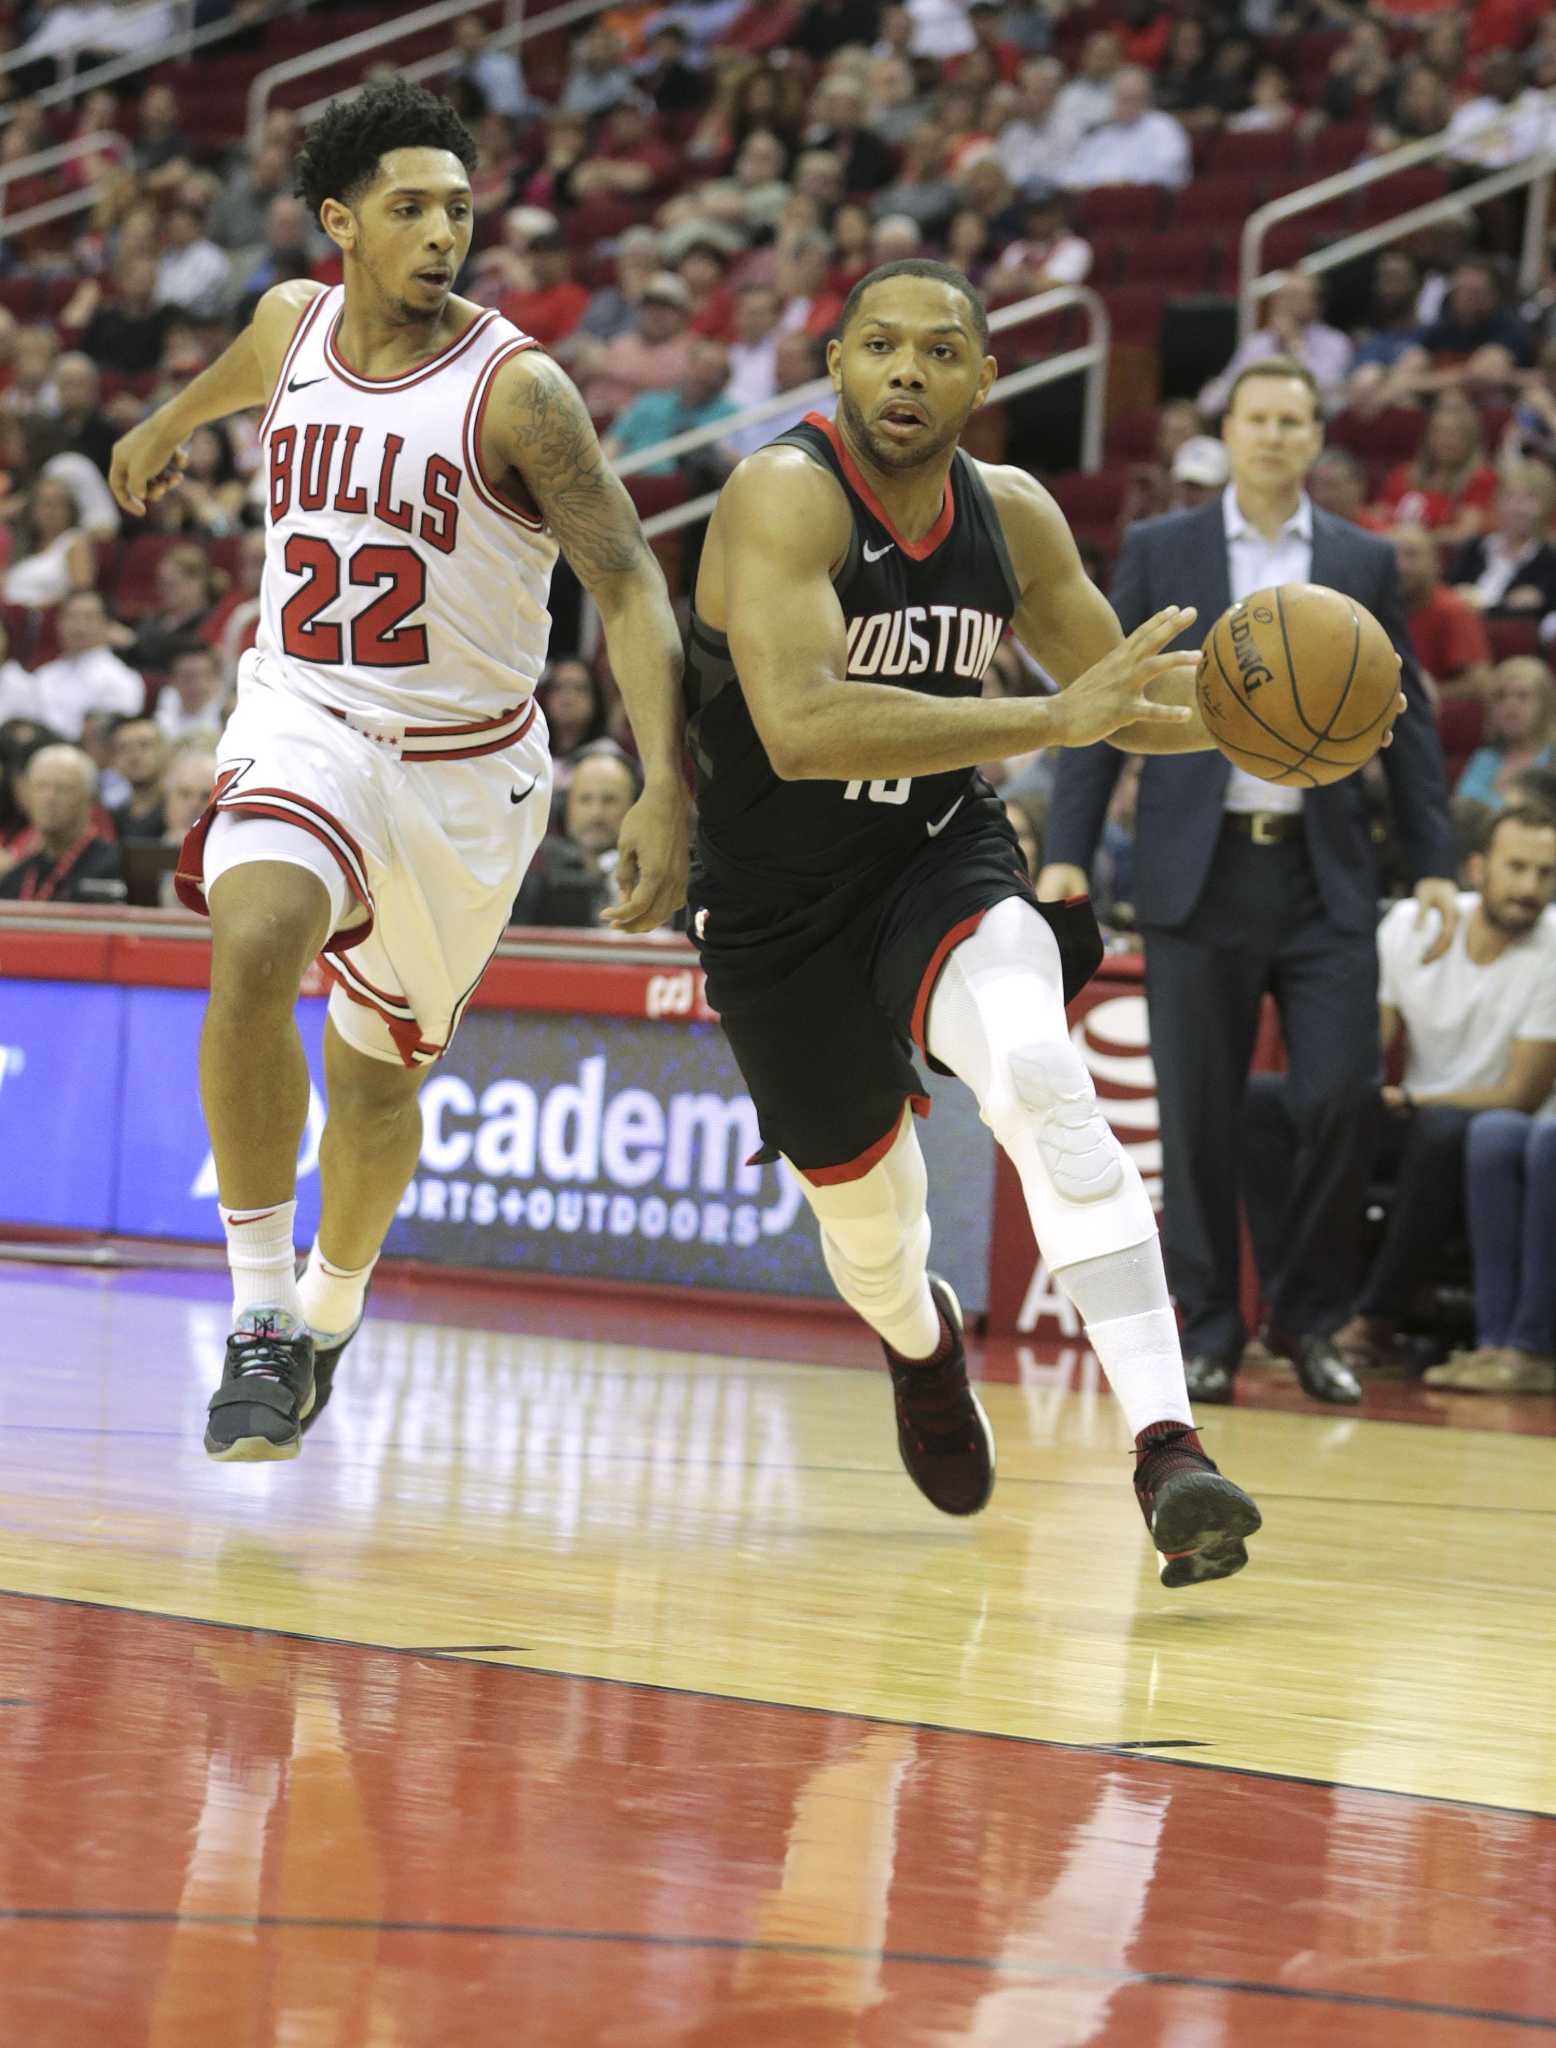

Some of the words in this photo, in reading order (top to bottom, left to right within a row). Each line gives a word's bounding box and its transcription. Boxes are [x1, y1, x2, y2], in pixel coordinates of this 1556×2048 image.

[269, 424, 463, 555] BULLS
[281, 532, 430, 668] 22
[396, 1178, 761, 1247] ORTS+OUTDOORS
